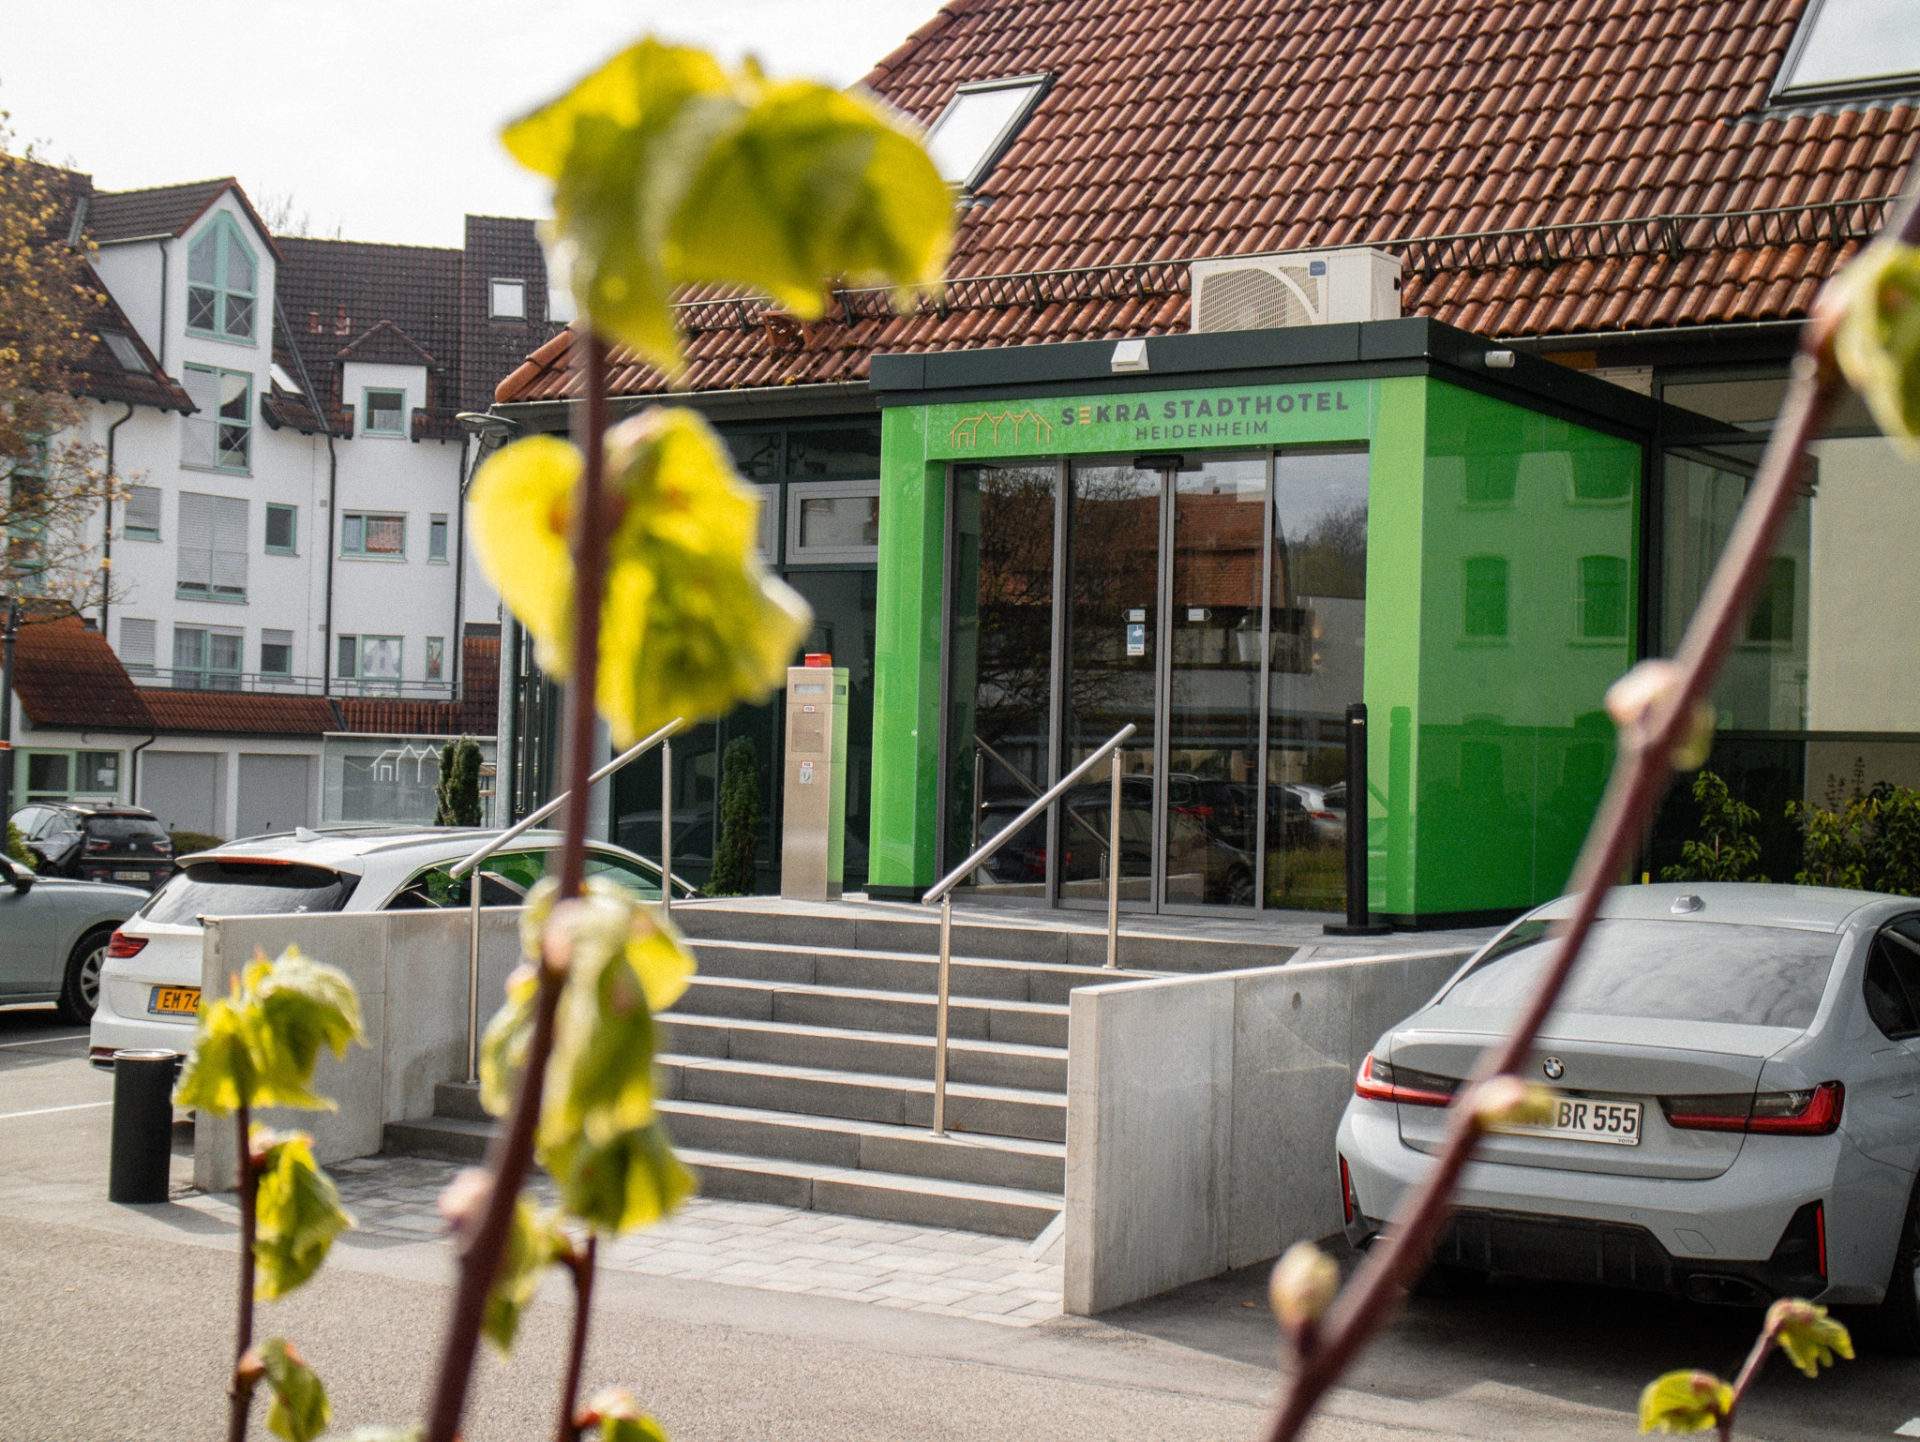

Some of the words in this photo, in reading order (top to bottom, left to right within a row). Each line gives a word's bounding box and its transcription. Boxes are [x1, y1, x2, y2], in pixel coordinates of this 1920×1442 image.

[1061, 402, 1151, 426] SEKRA
[1163, 391, 1349, 419] STADTHOTEL
[1136, 420, 1268, 440] HEIDENHEIM
[1557, 1102, 1587, 1130] BR
[1593, 1105, 1637, 1133] 555
